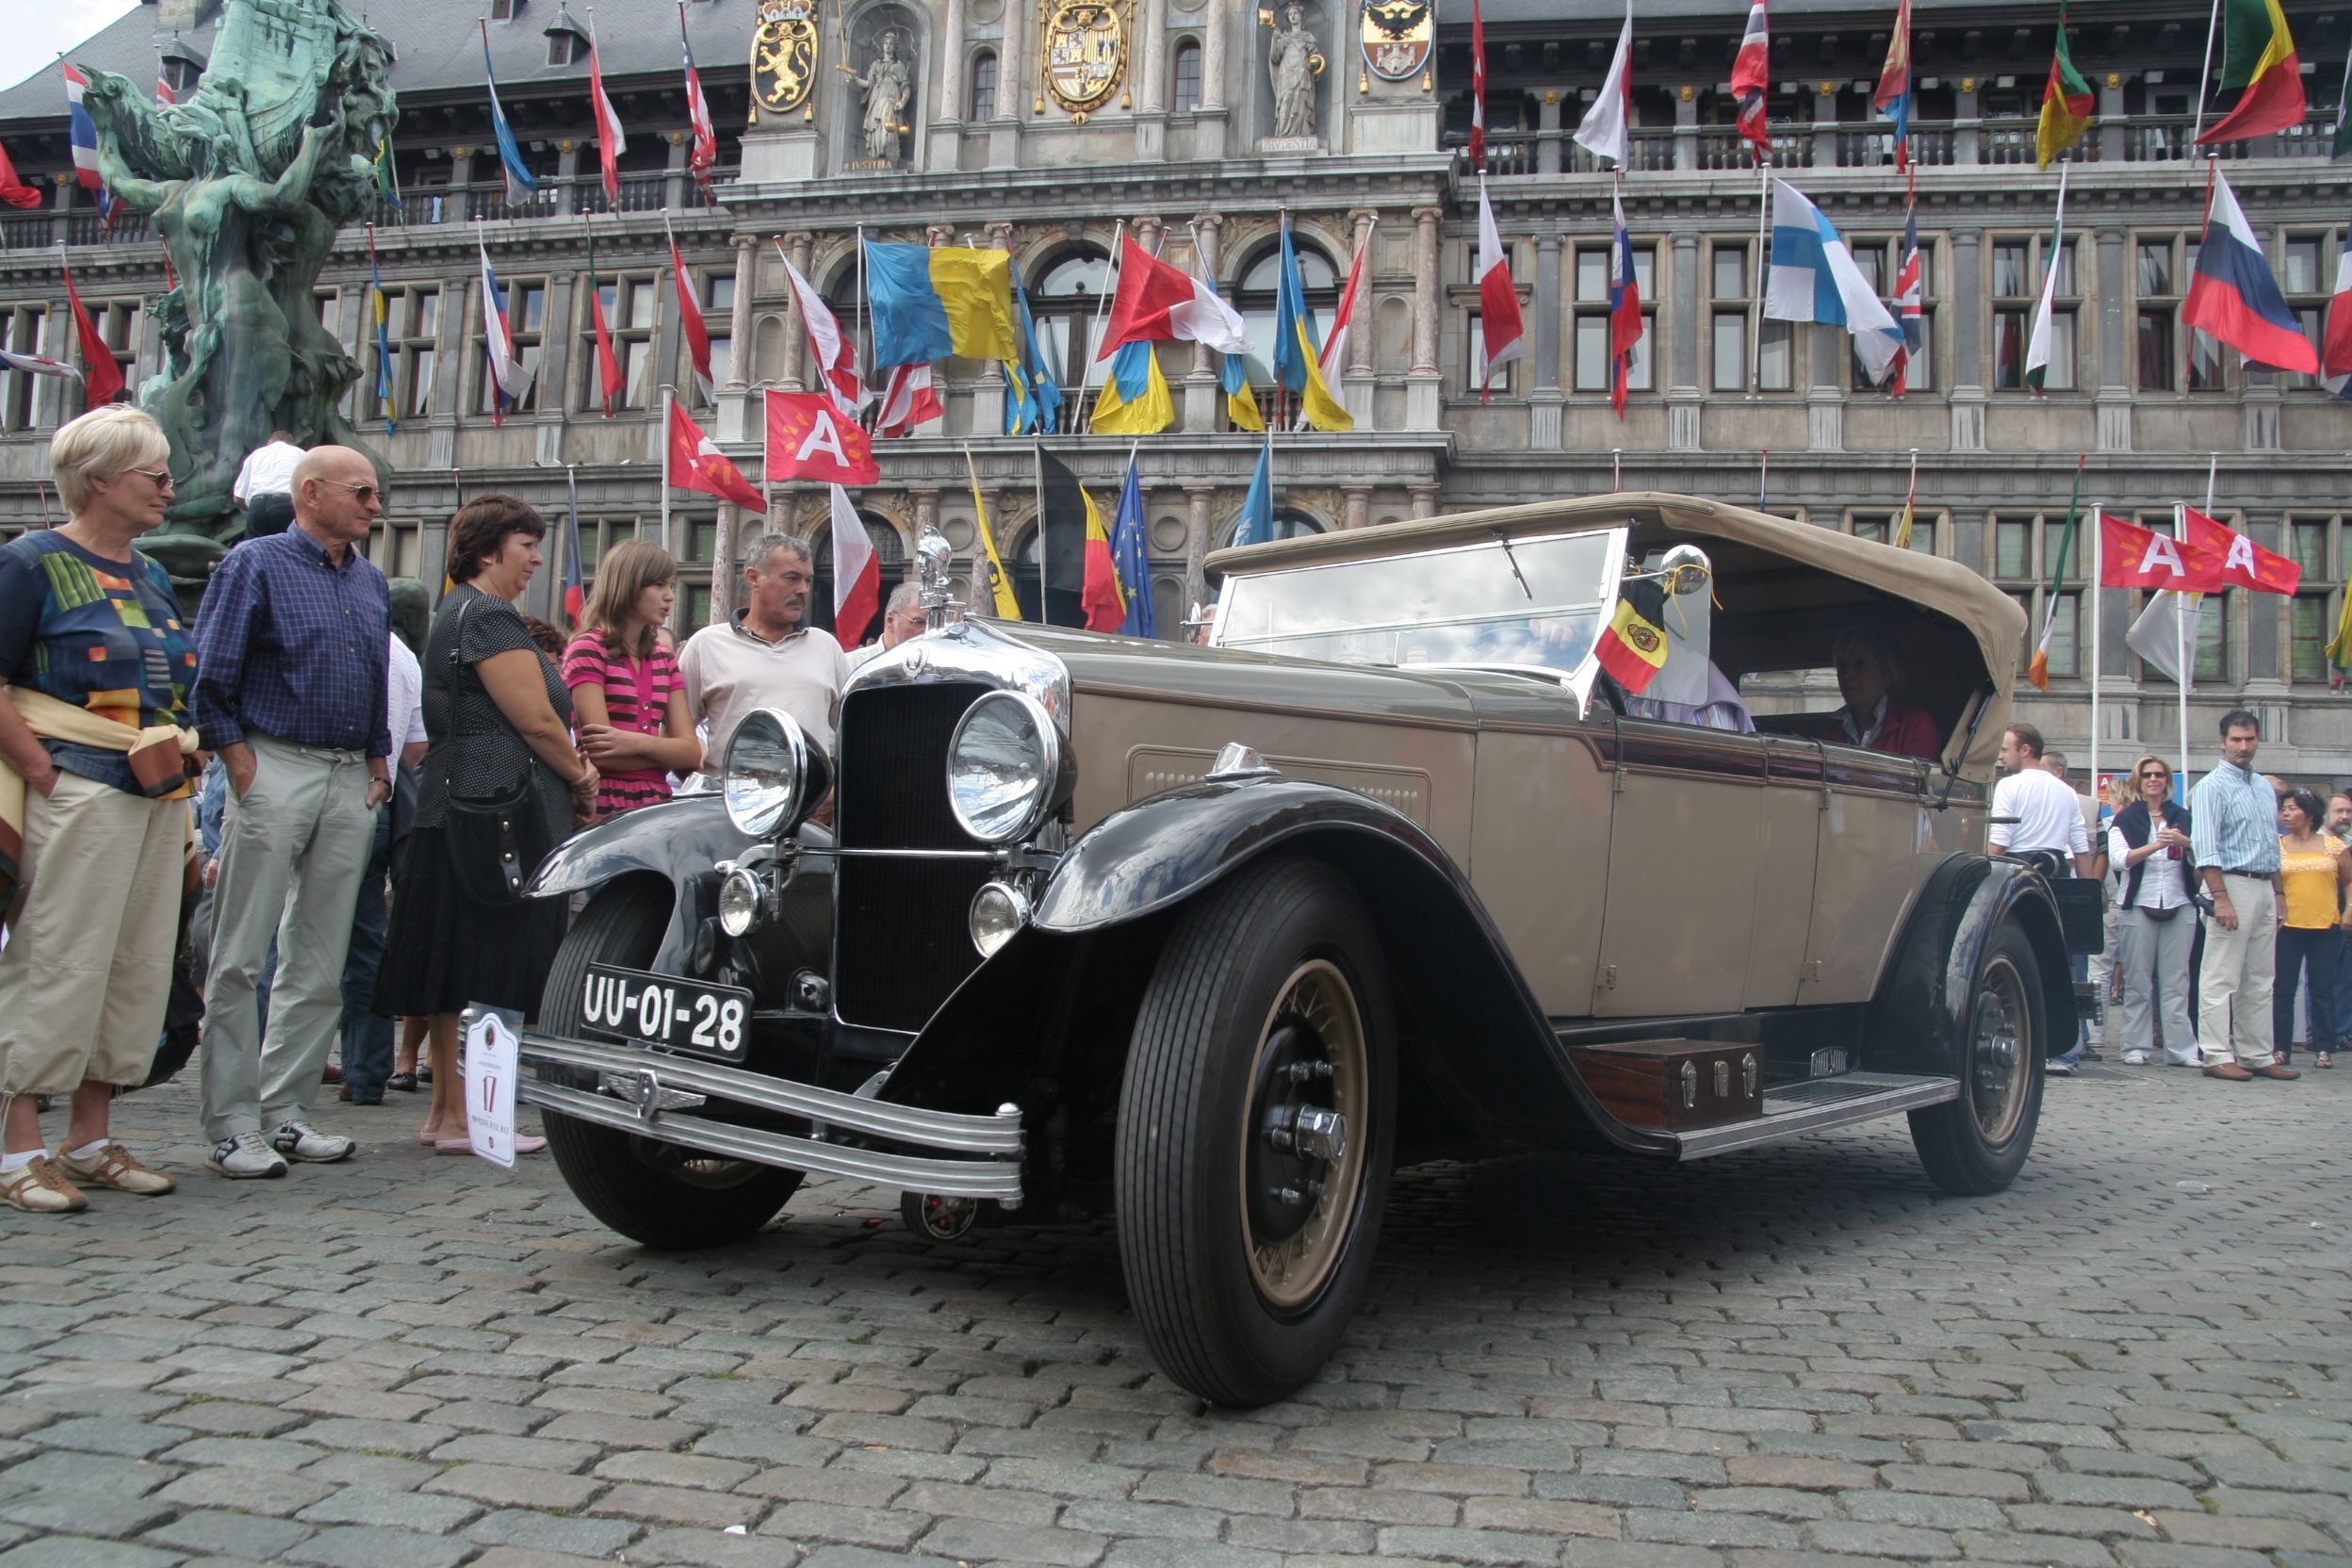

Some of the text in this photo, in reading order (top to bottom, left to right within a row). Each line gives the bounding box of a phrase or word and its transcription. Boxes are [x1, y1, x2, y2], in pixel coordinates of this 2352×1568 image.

[795, 409, 850, 466] A
[2138, 532, 2185, 576] A
[2225, 533, 2255, 580] A
[583, 973, 744, 1052] UU-01-28
[482, 1075, 497, 1113] 17
